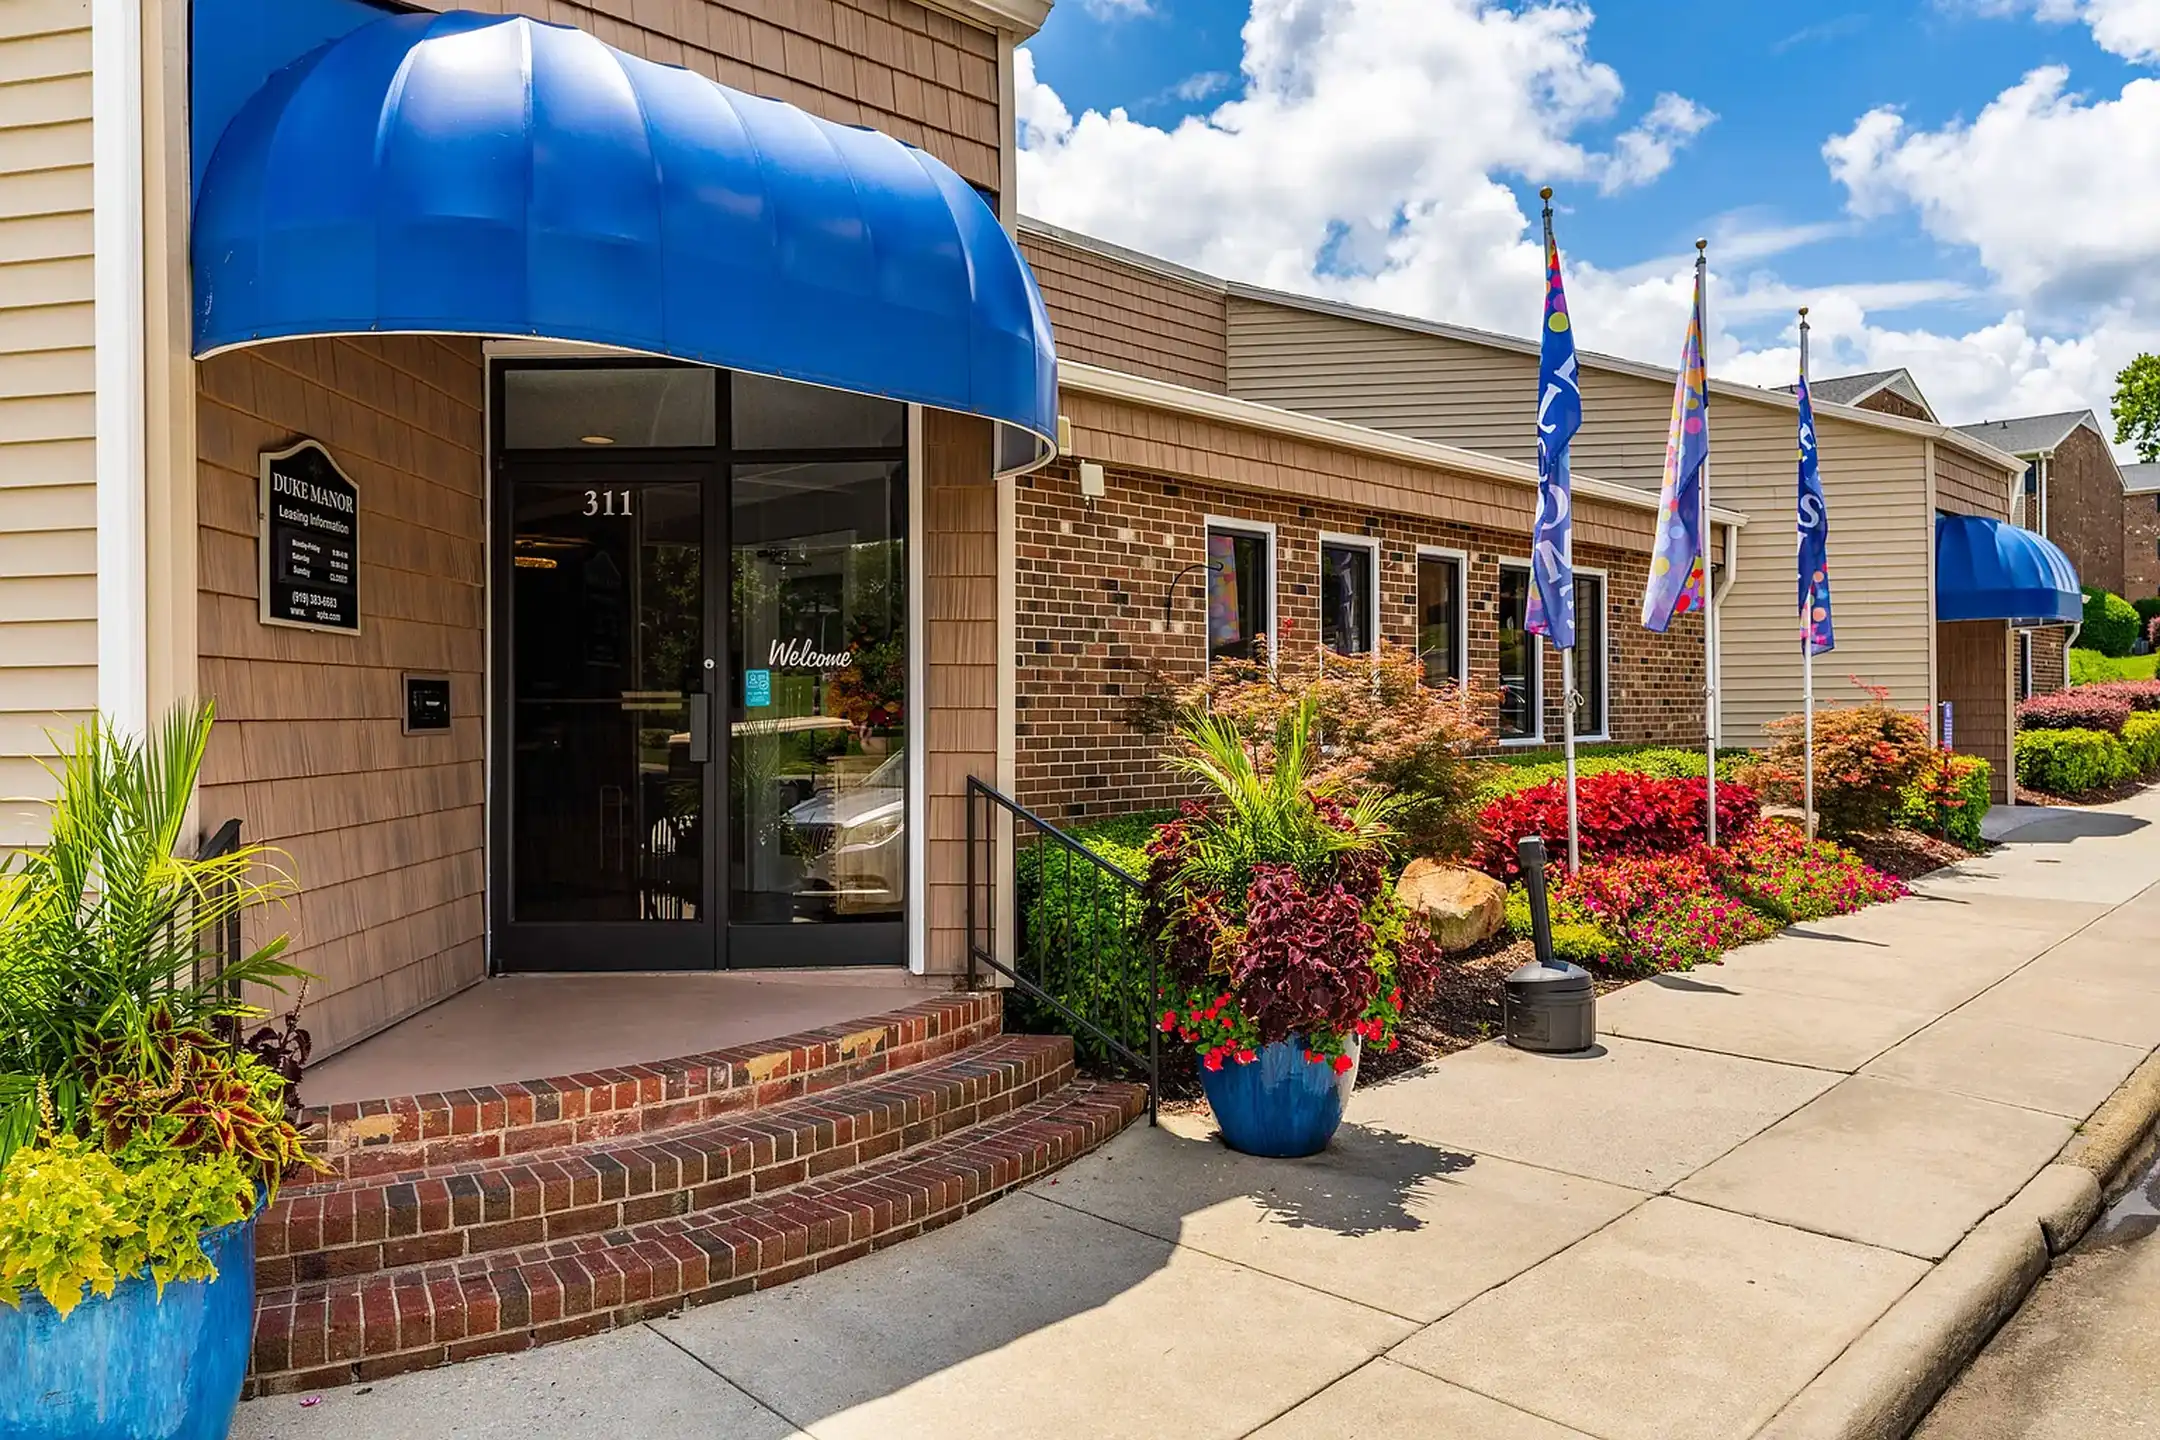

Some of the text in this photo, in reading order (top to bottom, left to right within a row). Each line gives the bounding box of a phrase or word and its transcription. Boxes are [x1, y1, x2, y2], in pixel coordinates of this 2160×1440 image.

[273, 472, 353, 513] DUKE MANOR
[583, 490, 632, 516] 311
[279, 504, 349, 534] Leasing Information
[292, 590, 309, 606] (919)
[769, 638, 852, 667] Welcome
